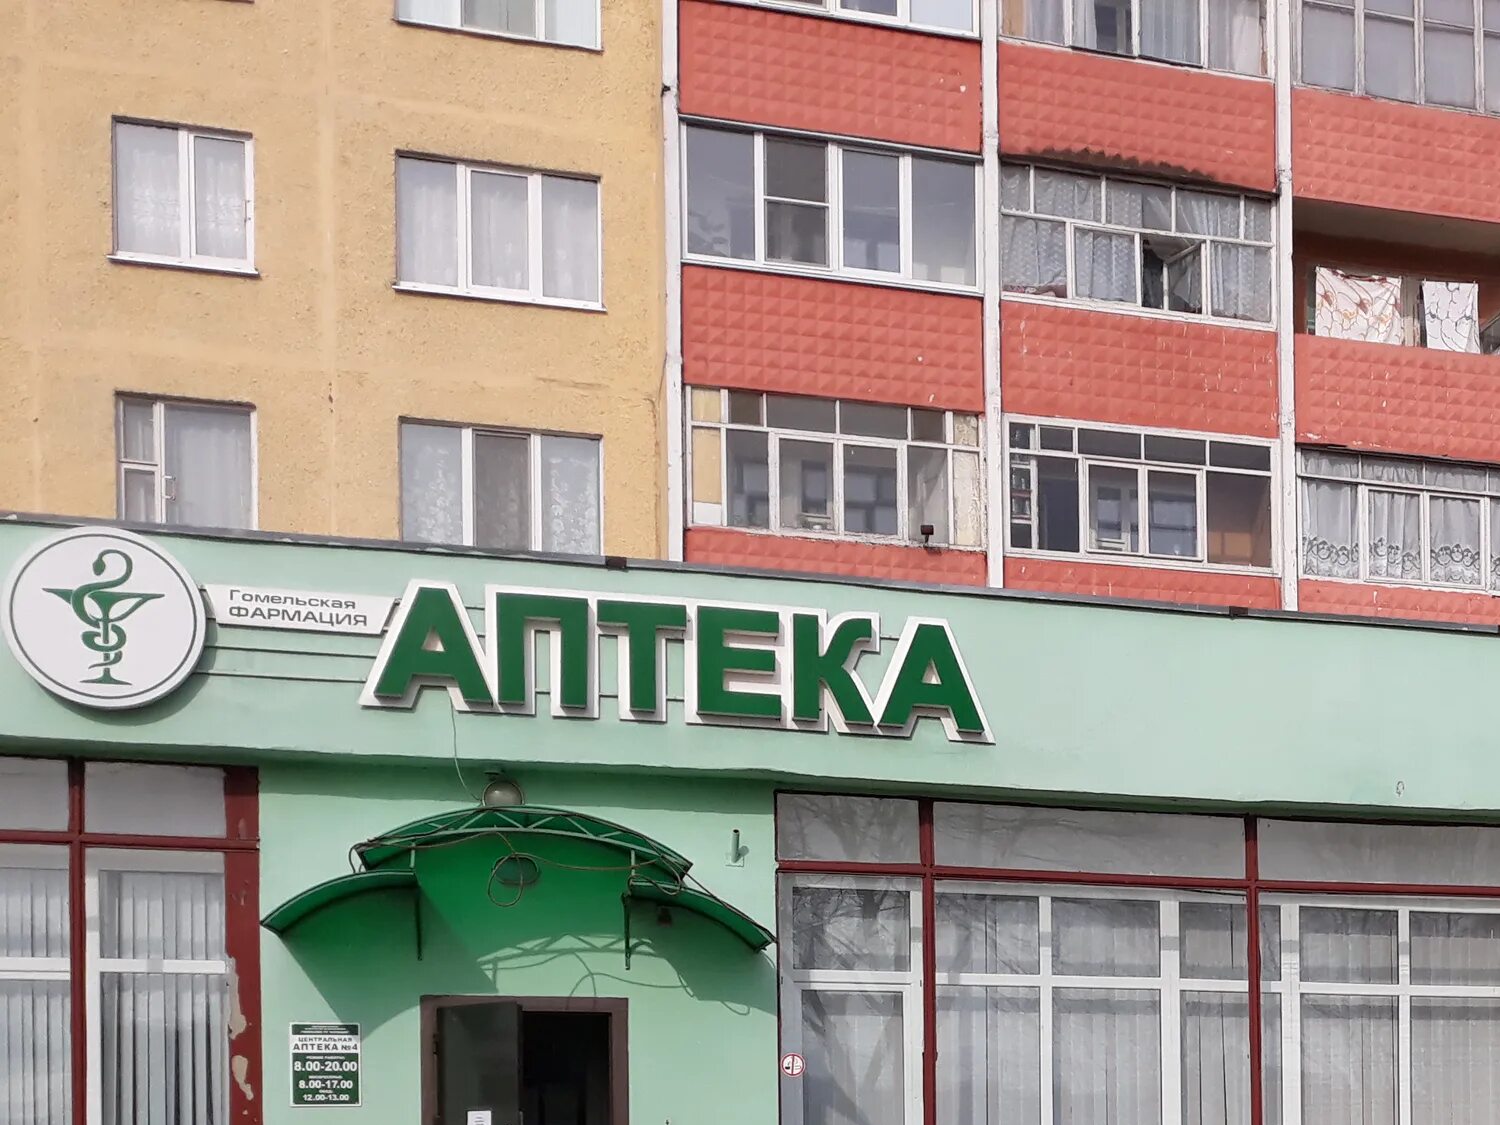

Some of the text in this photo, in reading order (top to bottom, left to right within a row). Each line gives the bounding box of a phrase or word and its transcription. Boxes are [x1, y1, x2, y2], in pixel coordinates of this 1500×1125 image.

[229, 589, 356, 610] Гомельская
[229, 606, 368, 627] ФАРМАЦИЯ
[373, 585, 984, 735] АПТЕКА
[292, 1043, 339, 1051] АПТЕКА
[293, 1060, 358, 1072] 8.00-20.00
[298, 1079, 354, 1089] 8.00-17.00
[302, 1093, 350, 1101] 12.00-13.00
